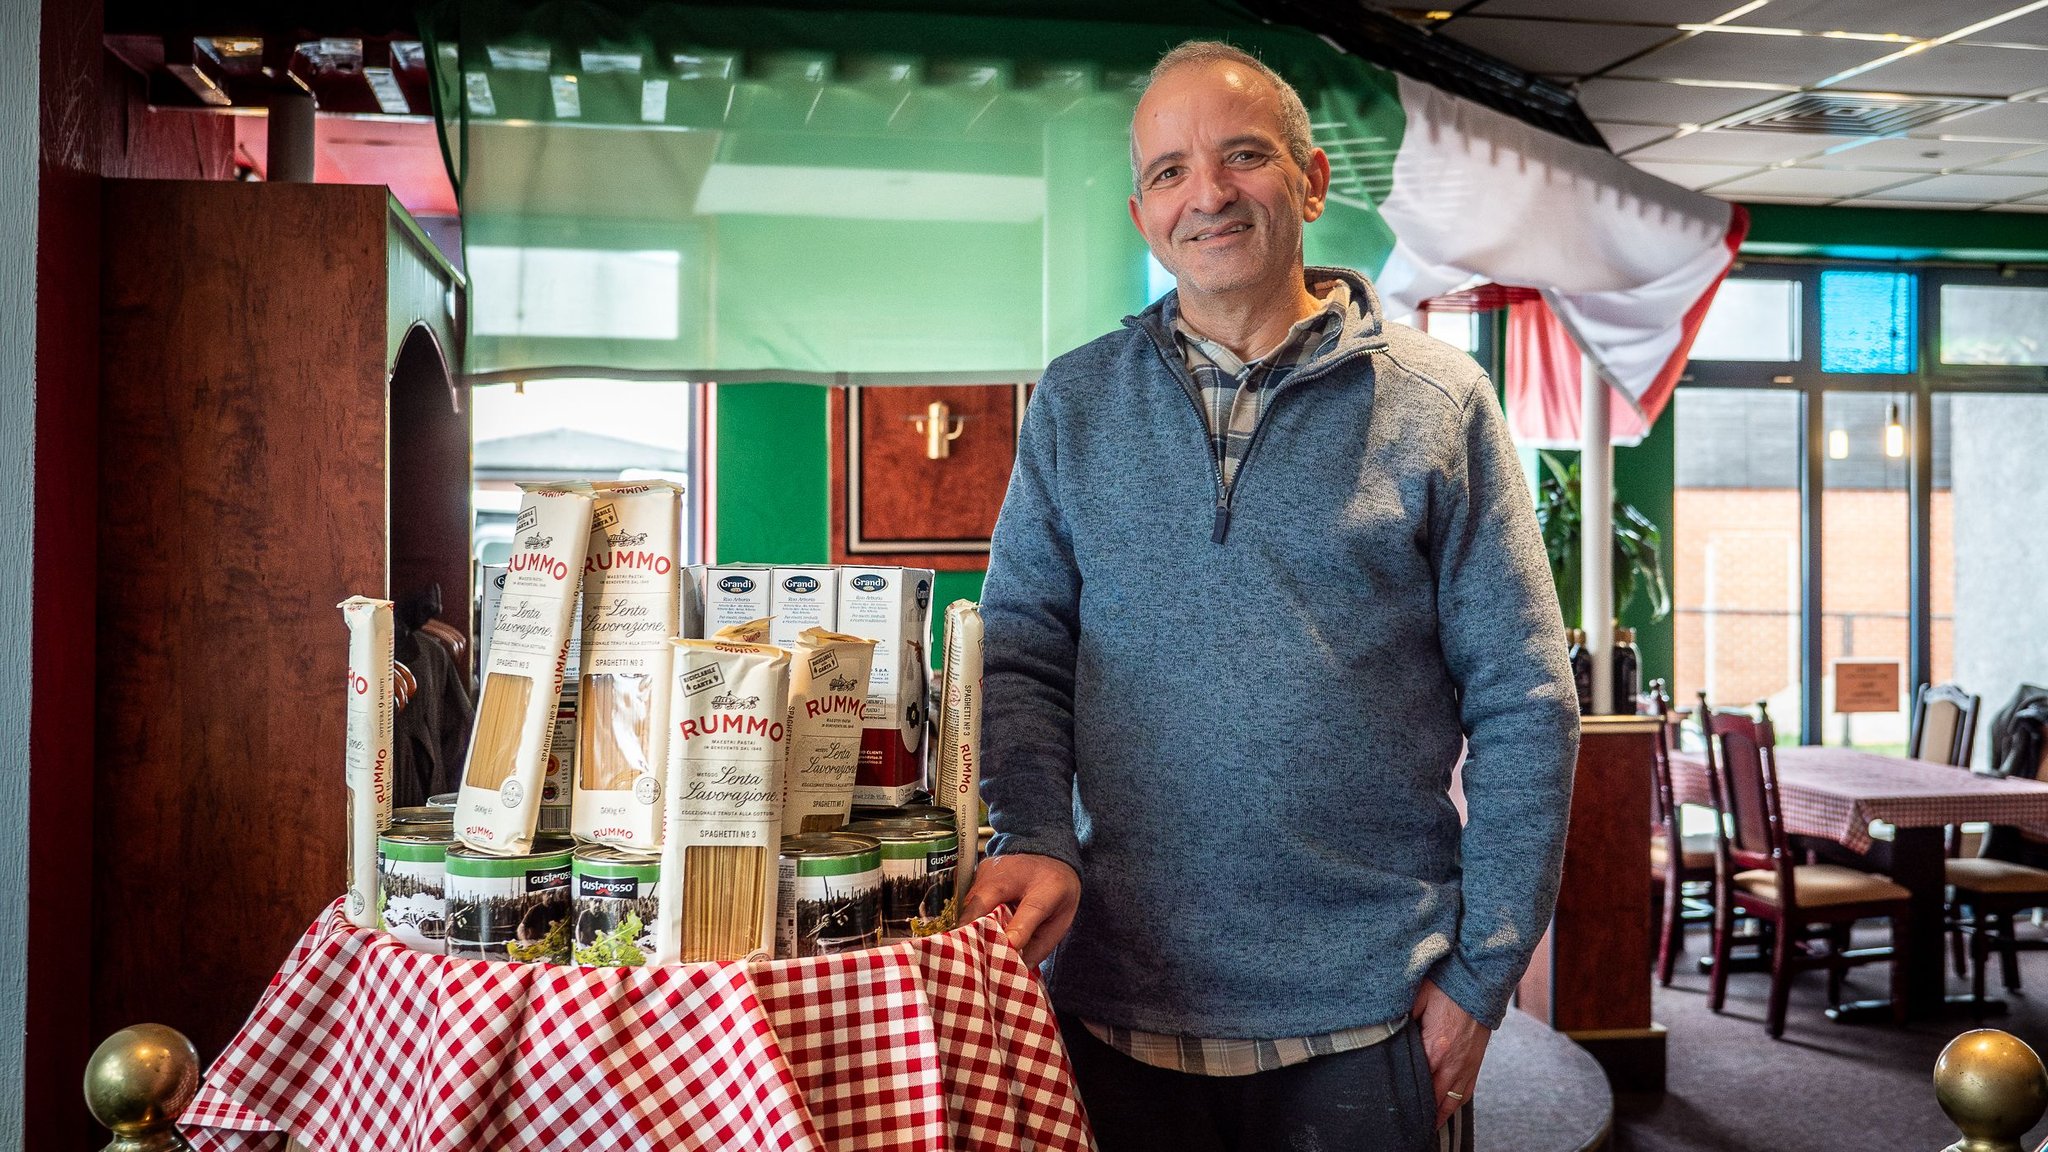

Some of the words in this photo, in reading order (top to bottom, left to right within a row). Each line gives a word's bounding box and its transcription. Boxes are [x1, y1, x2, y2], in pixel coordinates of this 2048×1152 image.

[584, 551, 671, 576] RUMMO
[720, 579, 752, 588] Grandi
[786, 579, 817, 588] Grandi
[853, 577, 884, 587] Grandi
[512, 601, 542, 619] Lenta
[606, 598, 649, 617] Lenta
[555, 638, 571, 695] RUMMO
[595, 659, 628, 667] SPAGHETTI
[692, 679, 713, 690] CARTA
[806, 695, 867, 721] RUMMO
[963, 684, 972, 720] SPAGHETTI
[680, 714, 784, 742] RUMMO
[541, 722, 554, 762] SPAGHETTI
[823, 742, 851, 760] Lenta
[374, 749, 387, 804] RUMMO
[711, 766, 763, 785] Lenta
[801, 756, 857, 780] Lavorazion
[959, 743, 972, 794] RUMMO
[466, 826, 494, 841] RUMMO
[593, 828, 633, 840] RUMMO
[700, 830, 739, 838] SPAGHETTI
[752, 830, 757, 838] 3
